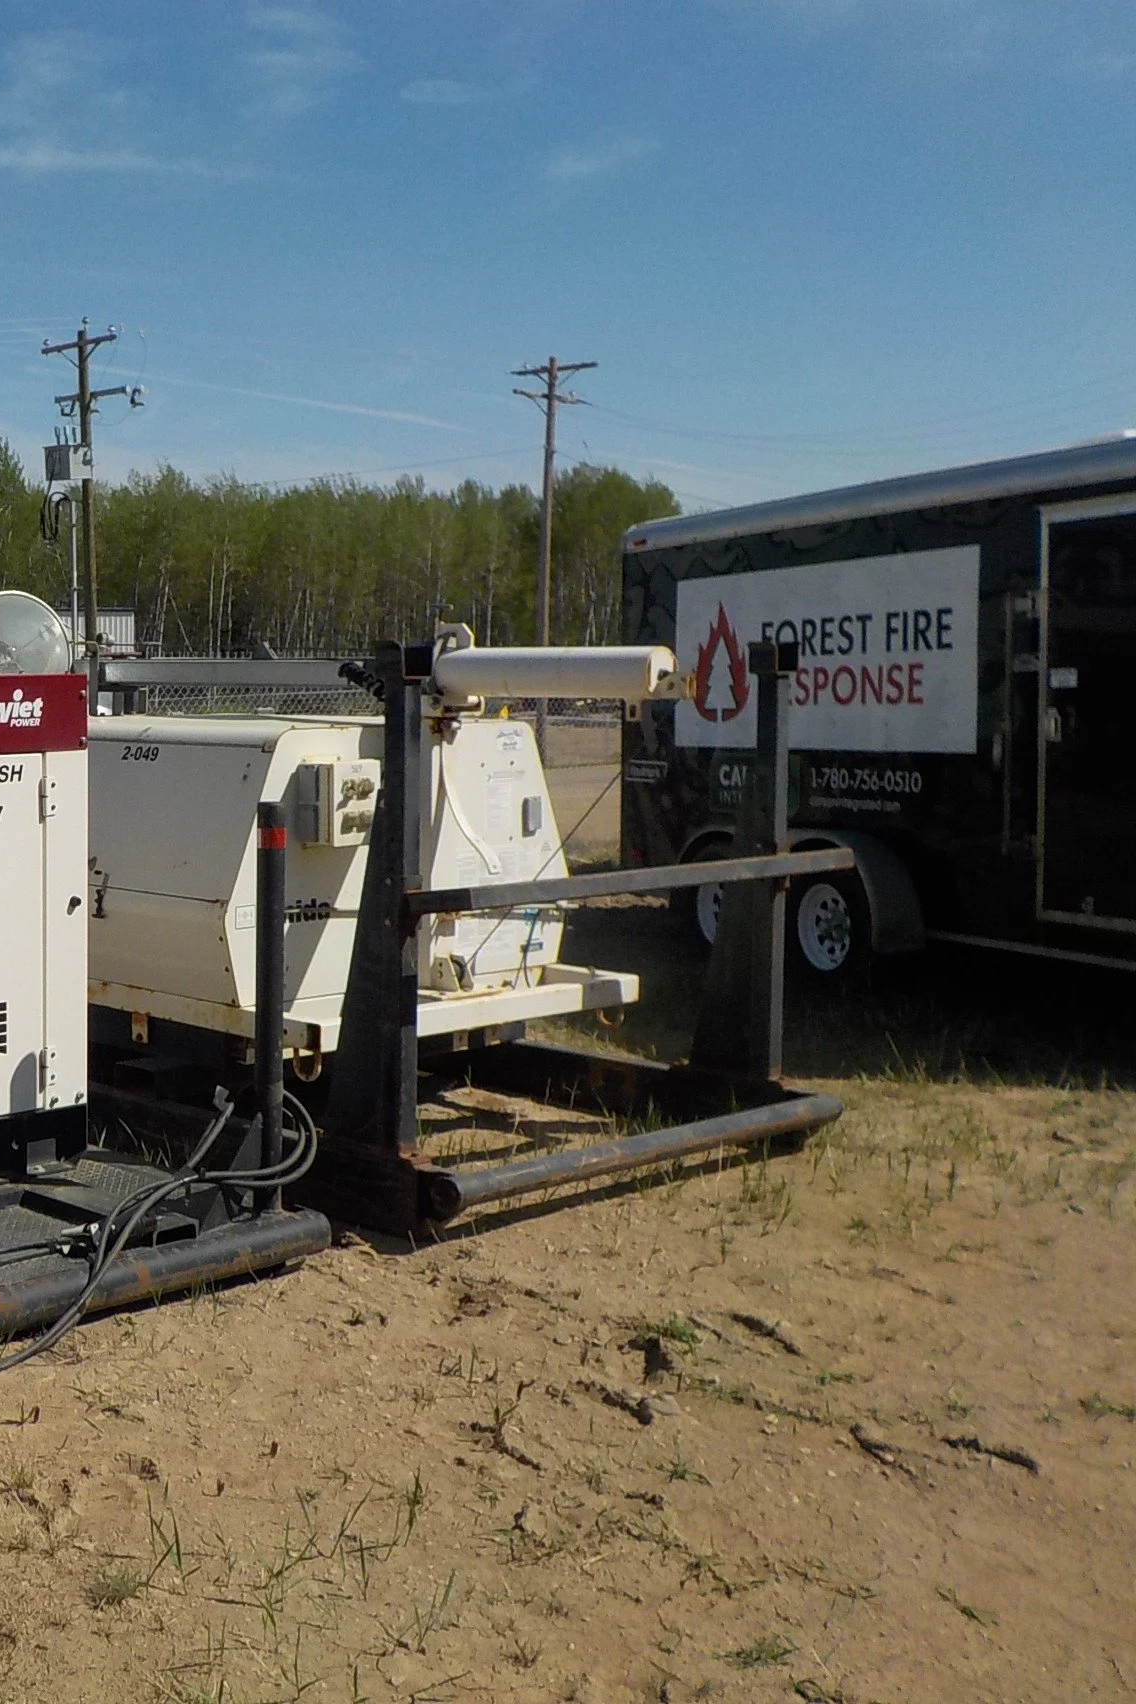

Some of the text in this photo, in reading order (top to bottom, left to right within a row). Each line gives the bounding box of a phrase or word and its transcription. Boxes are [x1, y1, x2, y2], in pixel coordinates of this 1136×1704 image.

[761, 607, 954, 657] FOREST FIRE
[793, 663, 925, 706] SPONSE
[9, 718, 41, 728] POWER
[120, 745, 160, 762] 2-049
